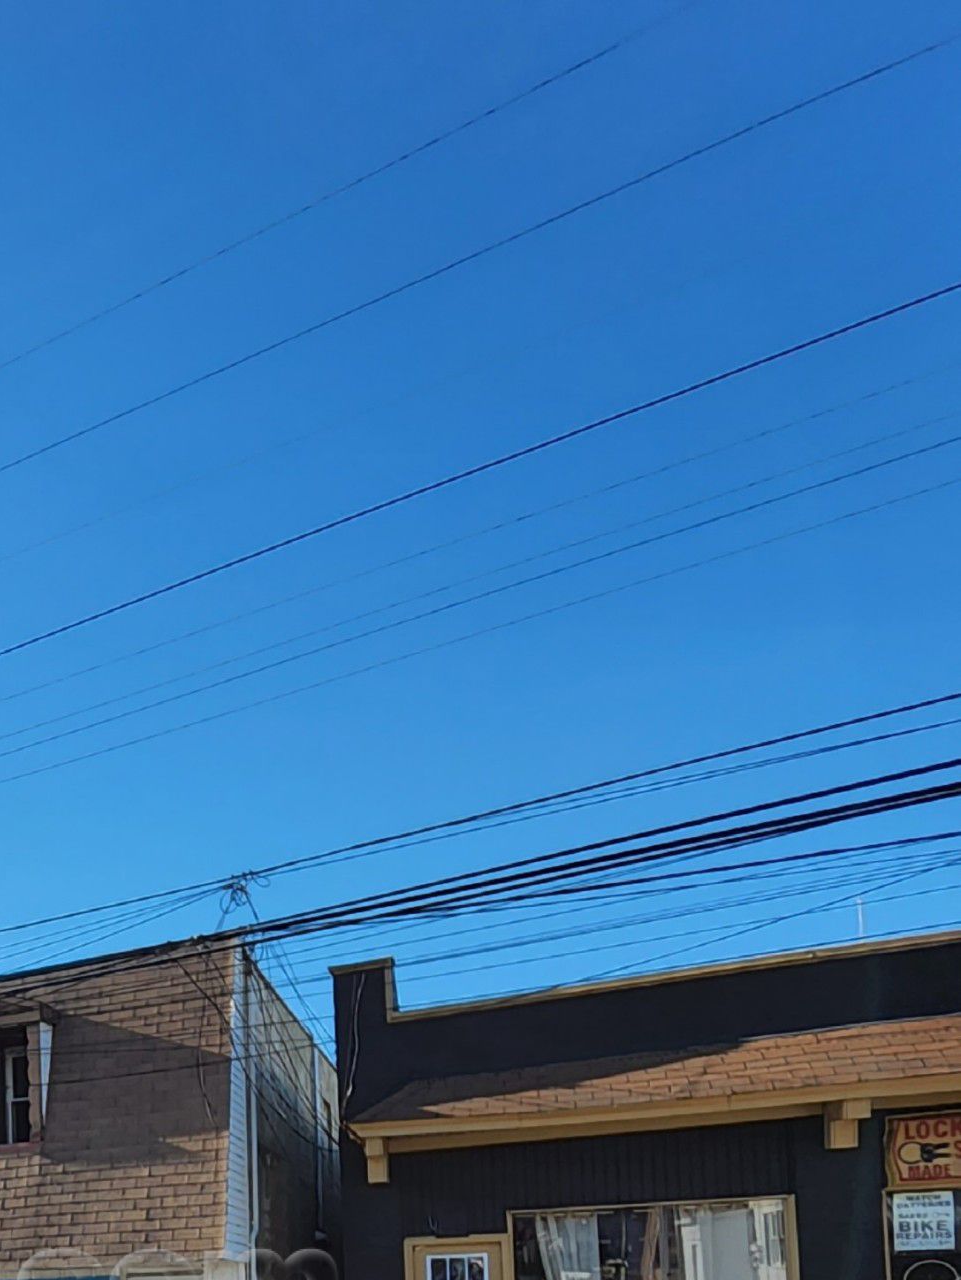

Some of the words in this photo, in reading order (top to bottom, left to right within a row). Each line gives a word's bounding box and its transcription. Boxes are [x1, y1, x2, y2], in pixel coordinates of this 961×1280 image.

[908, 1164, 951, 1180] MADE
[898, 1220, 949, 1233] BIKE
[896, 1231, 953, 1240] REPAIRS
